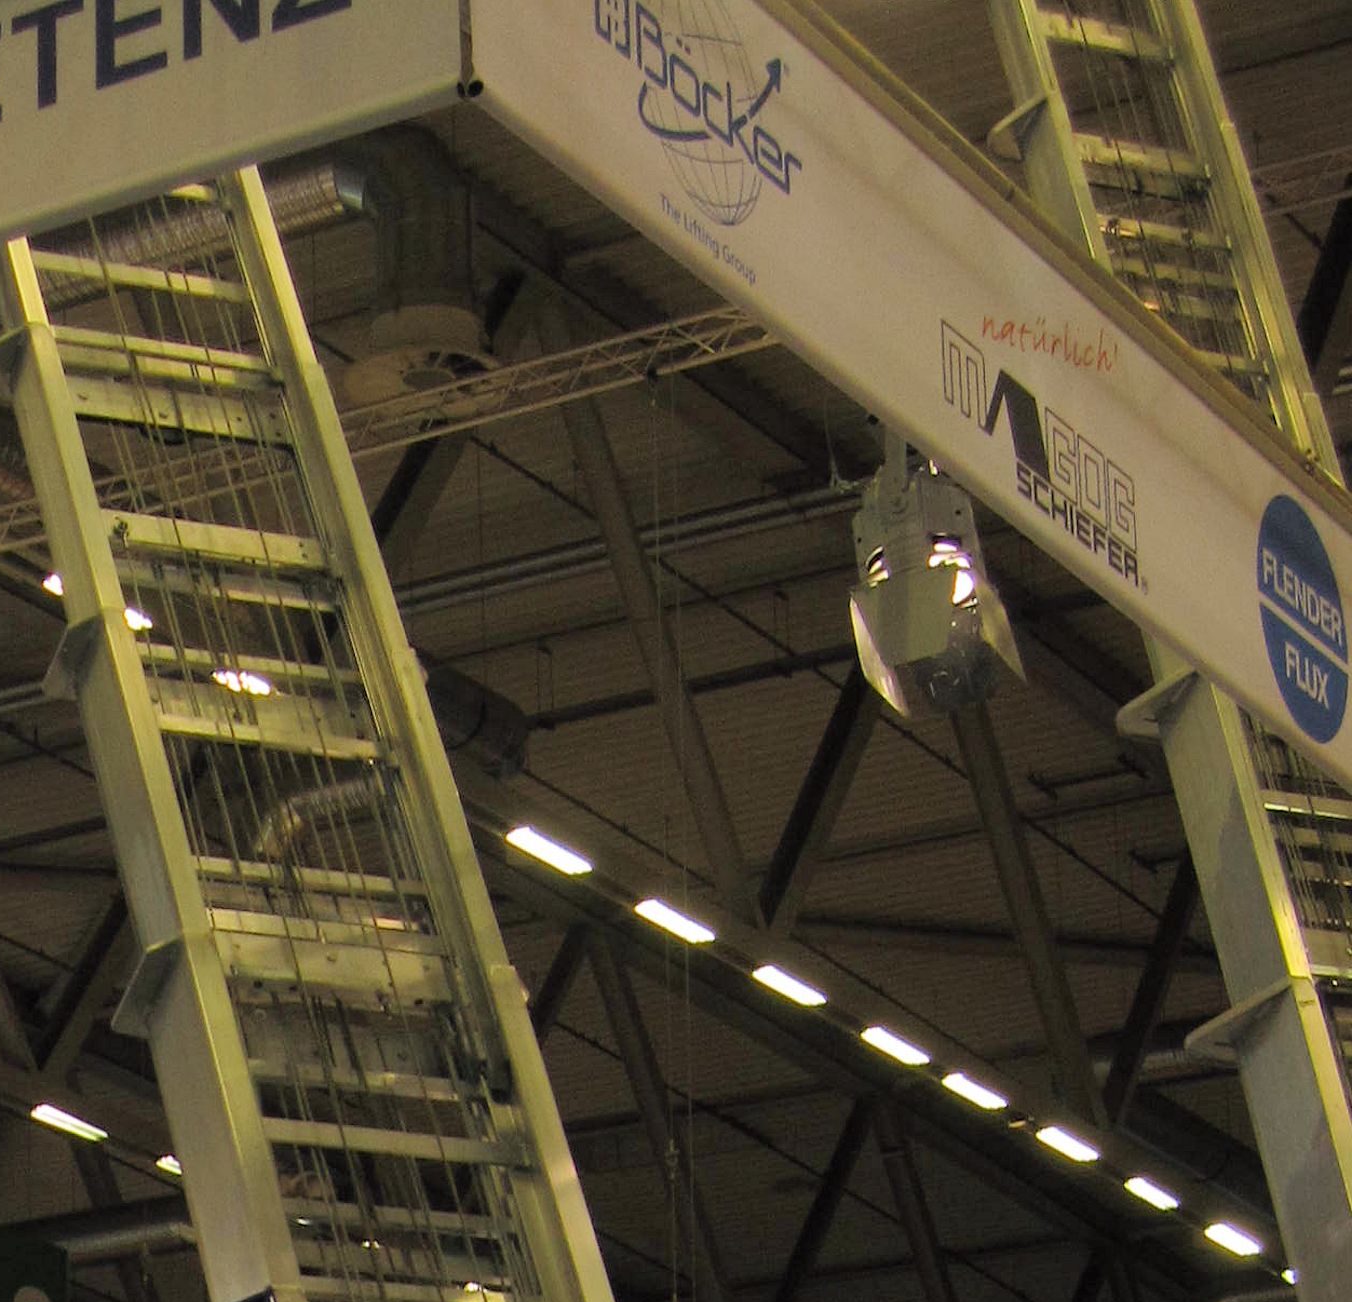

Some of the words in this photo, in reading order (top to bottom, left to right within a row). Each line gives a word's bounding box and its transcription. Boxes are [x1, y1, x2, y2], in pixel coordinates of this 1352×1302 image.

[635, 2, 803, 195] Böcker
[659, 192, 681, 225] The
[683, 211, 721, 260] Lifting
[722, 244, 757, 285] Group
[1016, 461, 1140, 588] SCHIEFER
[1261, 547, 1344, 647] FLENDER
[1284, 640, 1330, 710] FLUX
